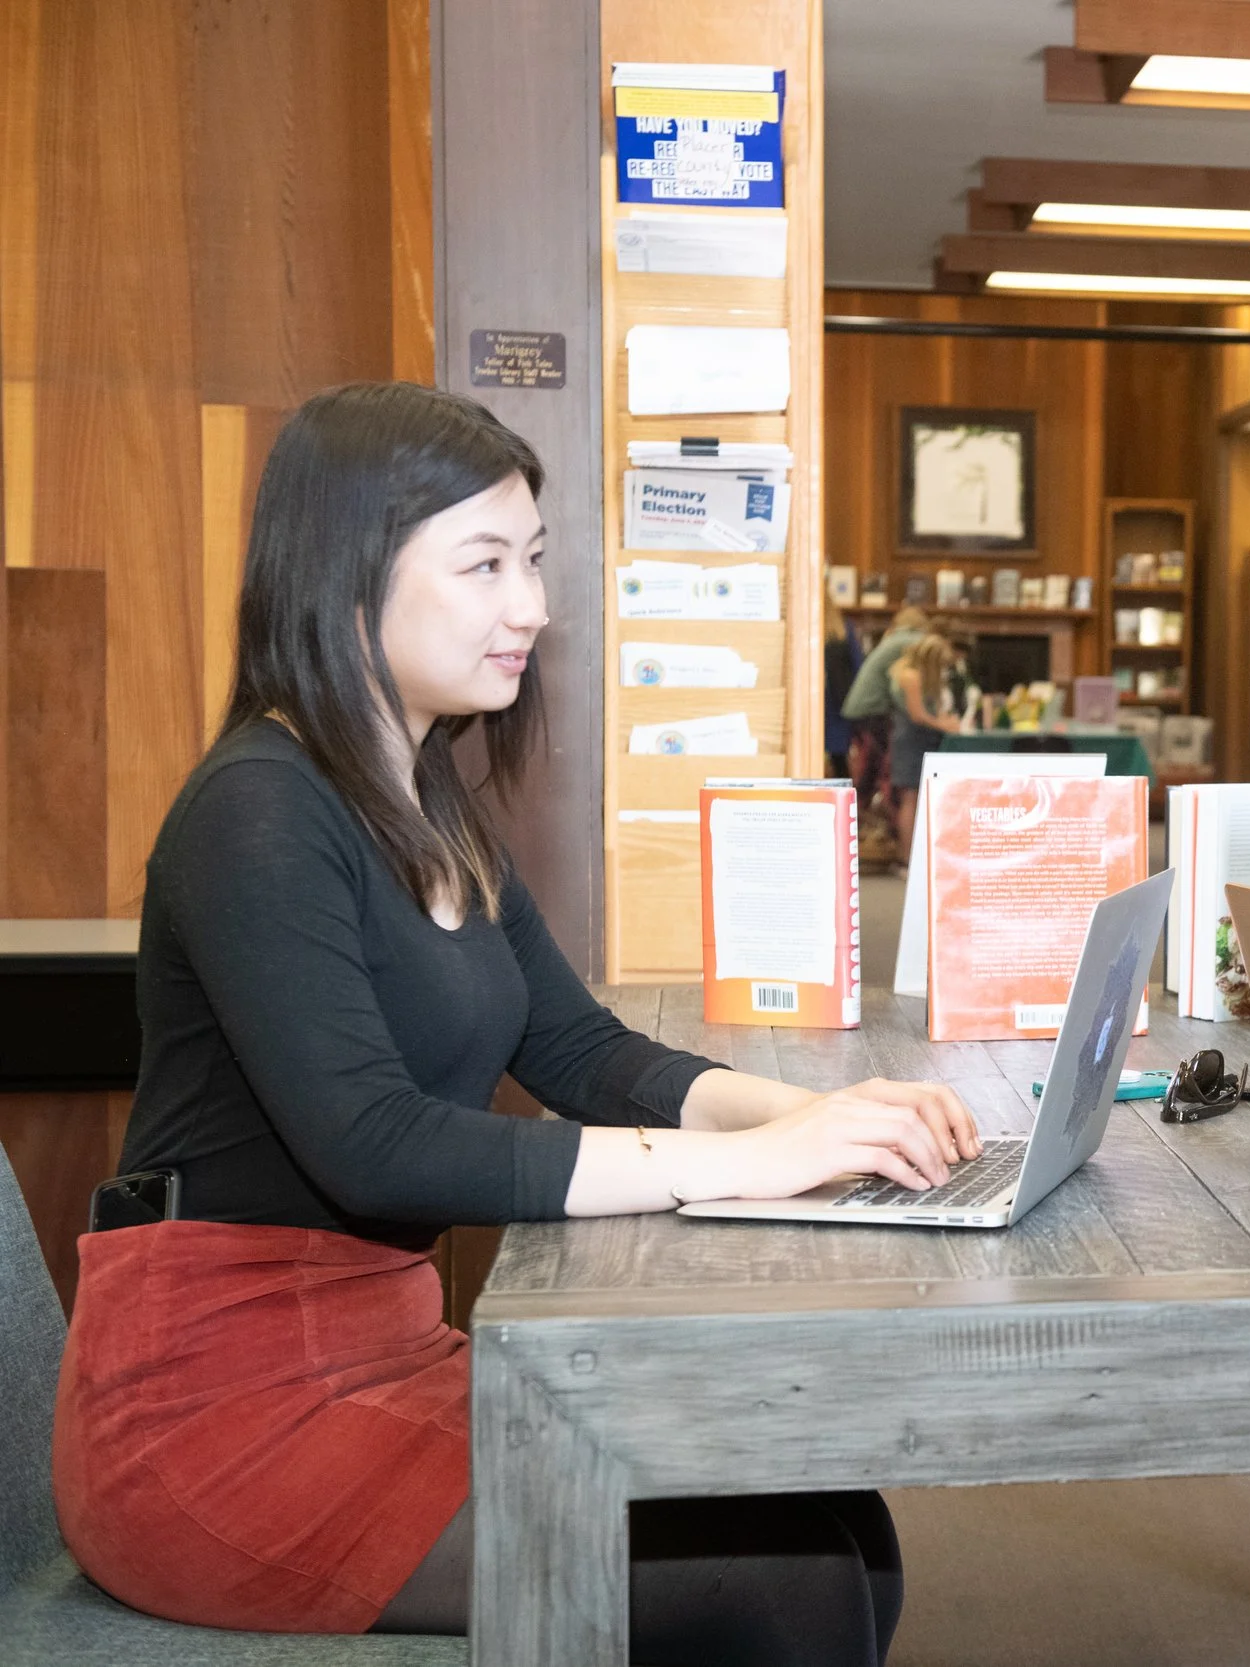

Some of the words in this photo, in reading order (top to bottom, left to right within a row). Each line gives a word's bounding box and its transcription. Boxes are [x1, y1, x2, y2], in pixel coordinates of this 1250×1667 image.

[636, 117, 674, 134] HAVE
[738, 163, 772, 178] VOTE
[655, 181, 679, 196] THE
[642, 484, 706, 502] Primary
[641, 500, 706, 517] Election
